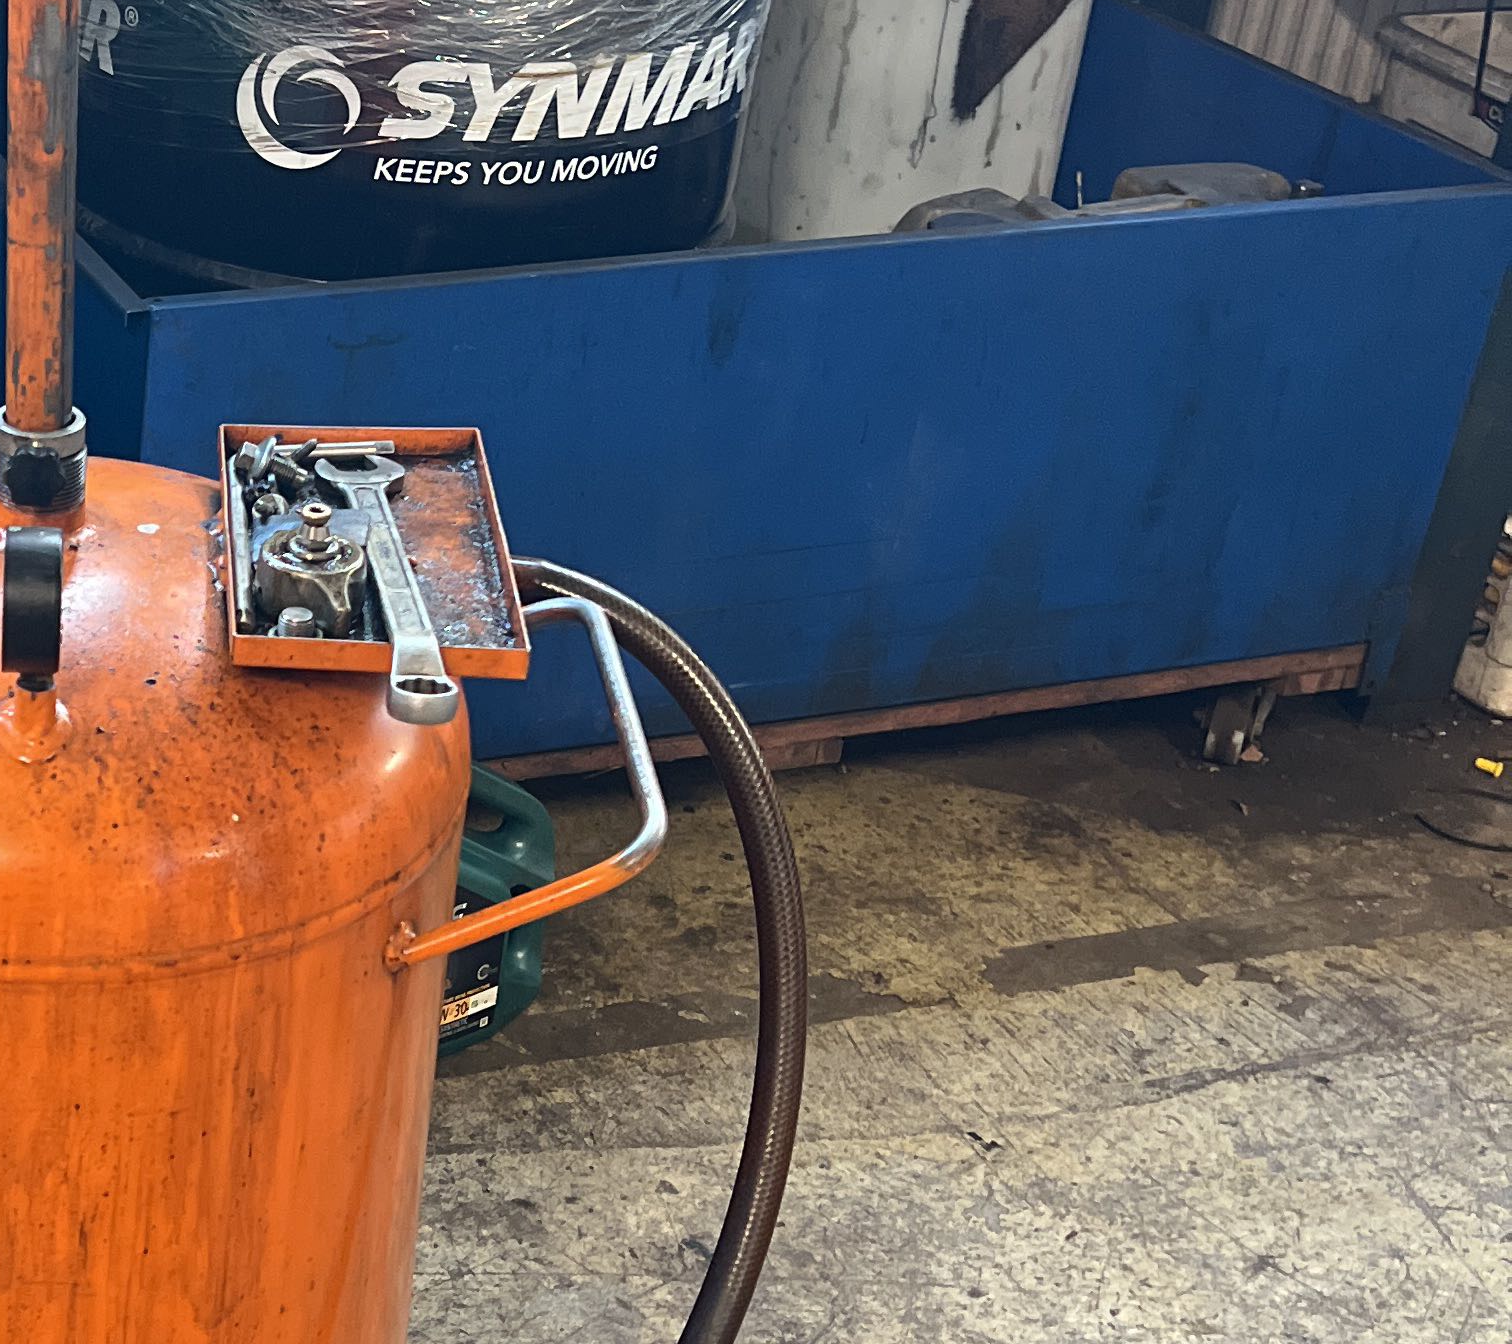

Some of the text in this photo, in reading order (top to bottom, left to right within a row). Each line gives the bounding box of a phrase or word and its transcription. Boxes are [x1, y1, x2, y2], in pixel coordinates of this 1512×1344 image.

[373, 145, 659, 186] KEEPS YOU MOVING
